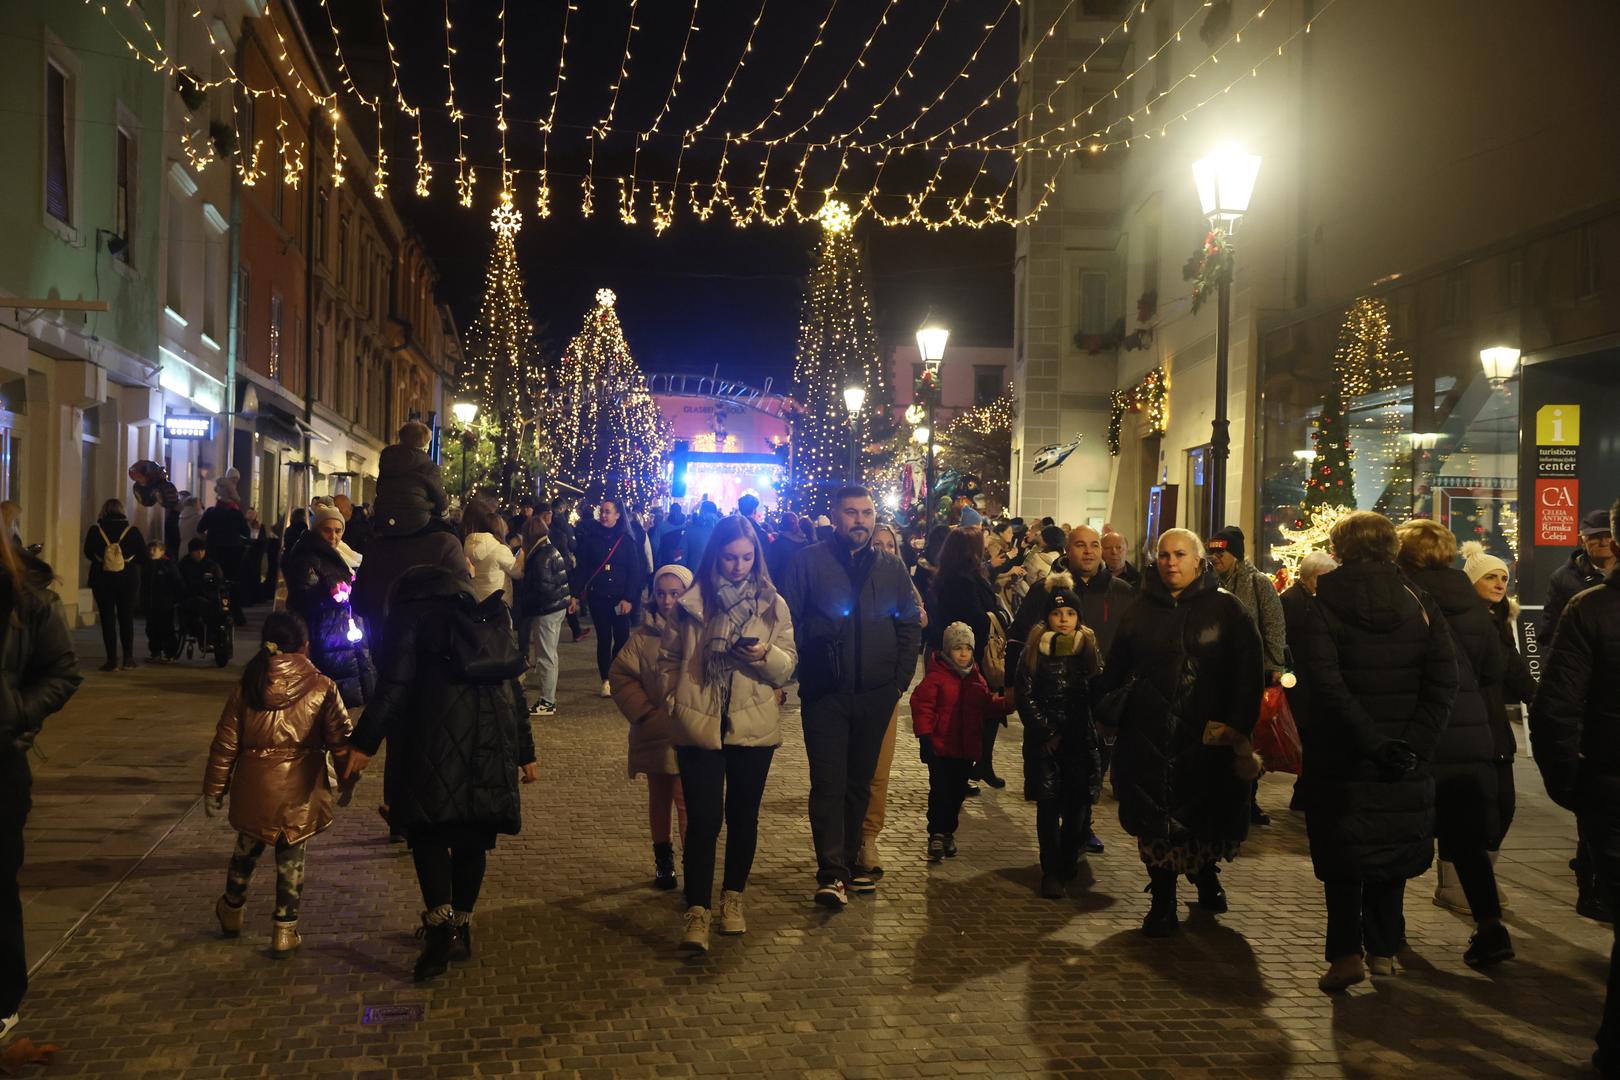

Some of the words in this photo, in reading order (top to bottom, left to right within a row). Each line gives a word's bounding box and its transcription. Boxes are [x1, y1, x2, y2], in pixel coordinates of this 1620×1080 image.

[1539, 448, 1576, 456] turistično
[1539, 462, 1576, 471] center
[1542, 486, 1574, 507] CA
[1542, 523, 1572, 532] Rimska
[1541, 531, 1568, 541] Celeja
[1524, 622, 1537, 653] OPEN
